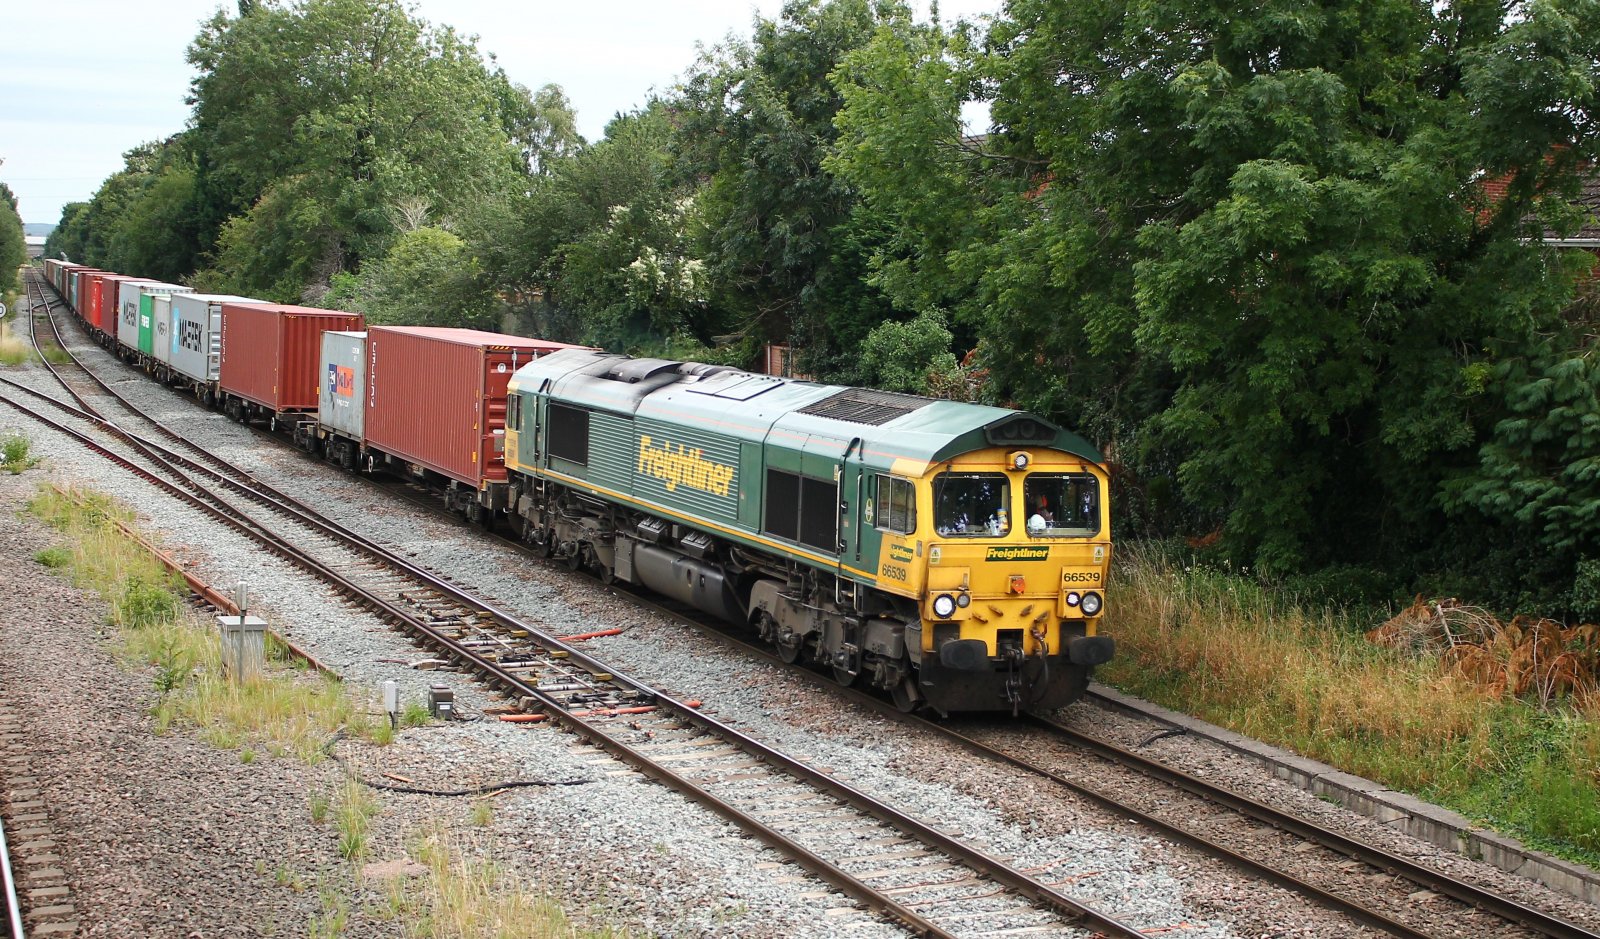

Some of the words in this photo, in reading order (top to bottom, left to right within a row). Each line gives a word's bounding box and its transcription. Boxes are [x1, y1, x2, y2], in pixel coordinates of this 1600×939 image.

[178, 318, 203, 354] MAERSK
[637, 434, 734, 497] Freightliner
[986, 547, 1048, 560] Freightliner
[882, 563, 907, 582] 66539
[1063, 571, 1101, 583] 66539
